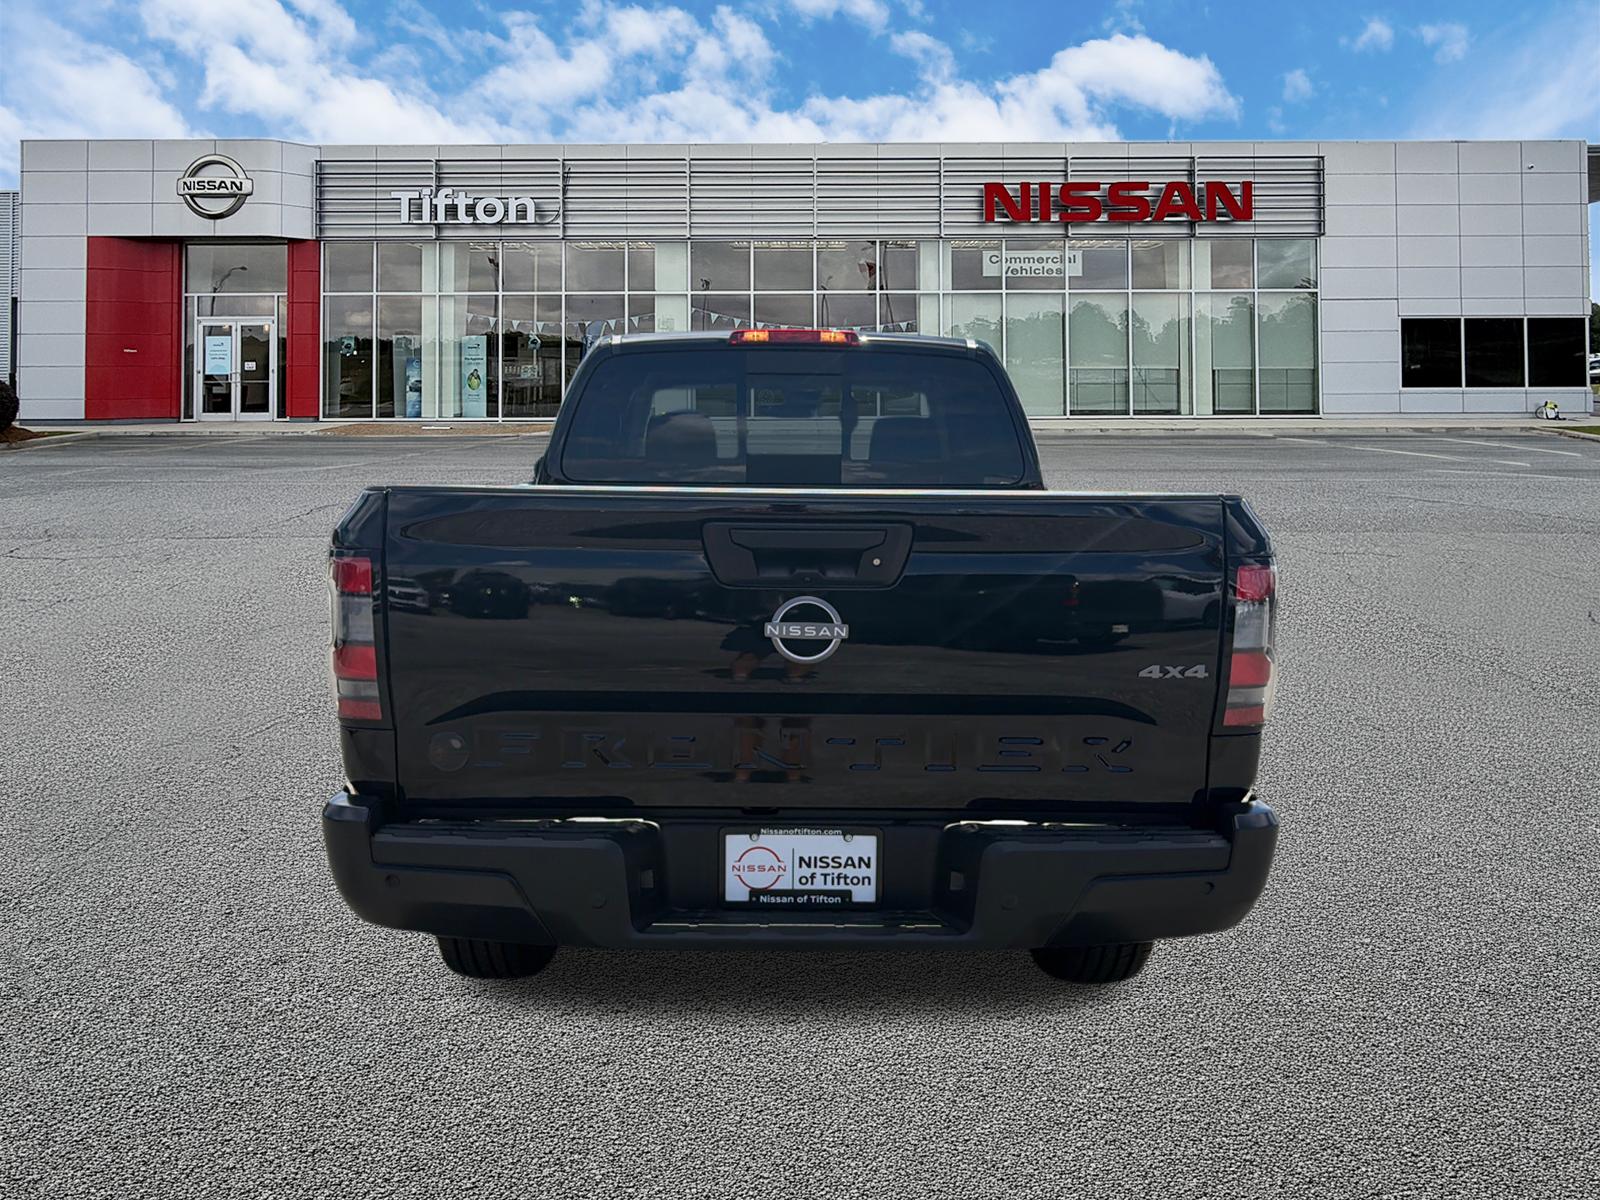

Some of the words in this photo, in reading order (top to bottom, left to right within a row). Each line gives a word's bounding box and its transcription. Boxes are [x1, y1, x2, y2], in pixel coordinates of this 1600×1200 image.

[183, 180, 243, 191] NISSAN
[390, 188, 536, 224] Tifton
[984, 181, 1253, 222] NISSAN
[767, 625, 847, 637] NISSAN
[760, 827, 843, 836] Nissanoftifton.com
[731, 864, 788, 873] NISSAN
[799, 856, 872, 870] NISSAN
[798, 873, 817, 886] of
[821, 873, 872, 887] Tifton
[759, 895, 794, 904] Nissan
[796, 895, 808, 904] of
[810, 895, 842, 904] Tifton
